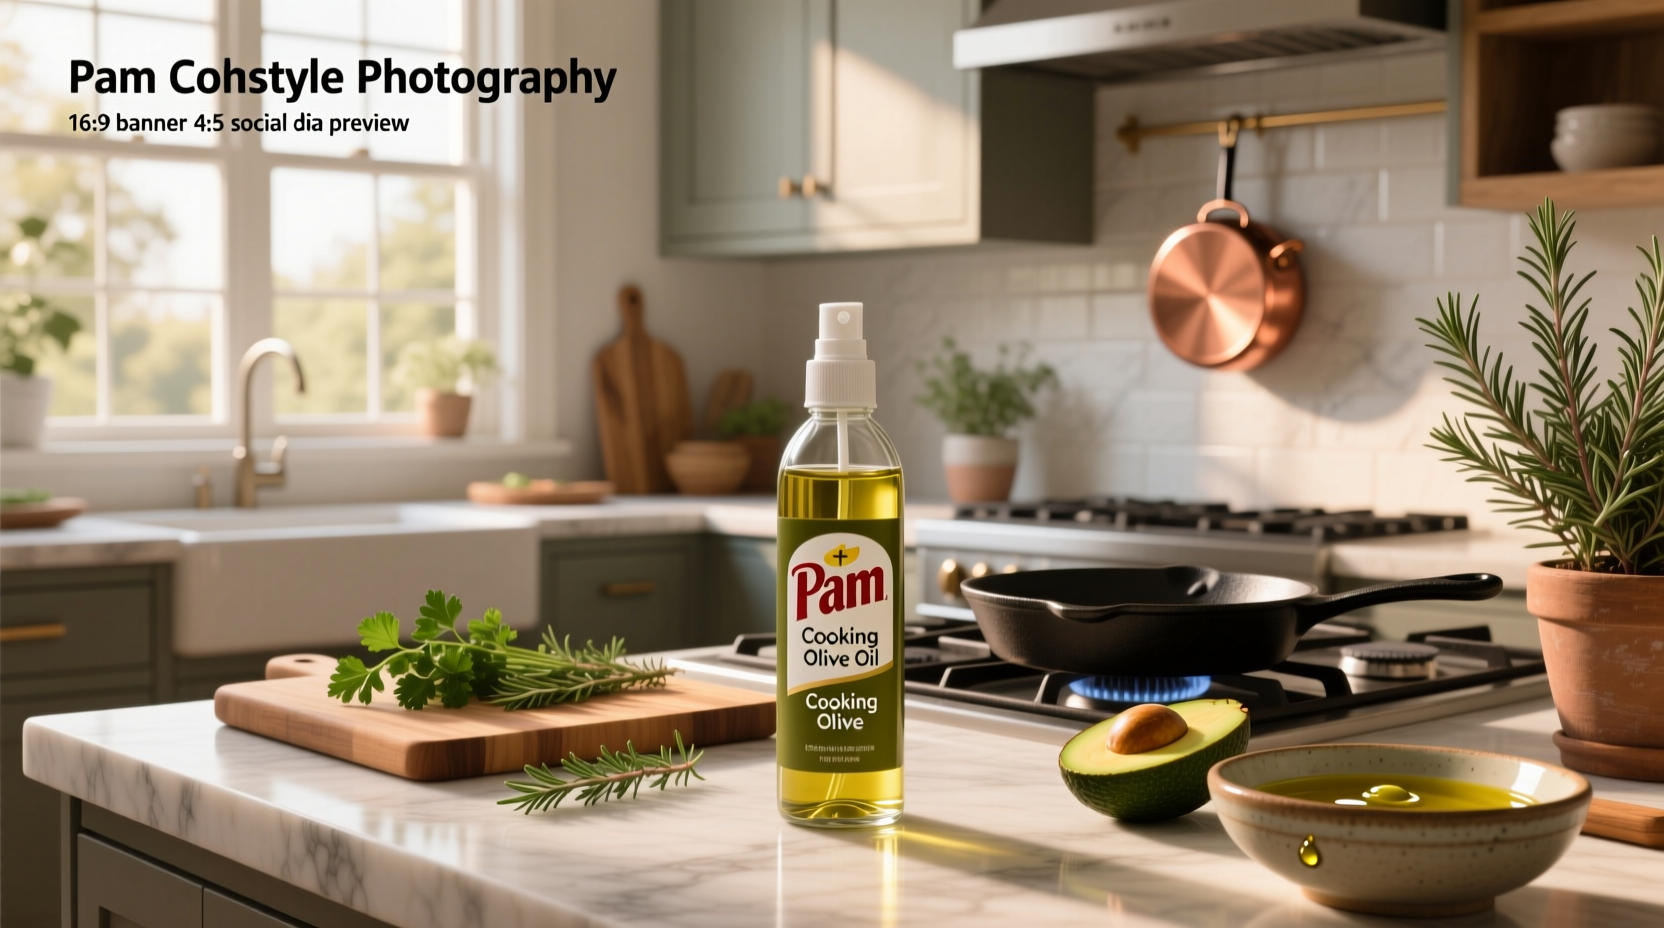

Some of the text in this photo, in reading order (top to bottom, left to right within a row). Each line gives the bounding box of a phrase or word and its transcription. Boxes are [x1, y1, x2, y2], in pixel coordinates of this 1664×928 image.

[791, 562, 886, 622] Pam
[802, 627, 878, 647] Cooking
[804, 649, 879, 667] Olive Oil
[805, 692, 878, 714] Cooking
[817, 713, 864, 730] Olive
